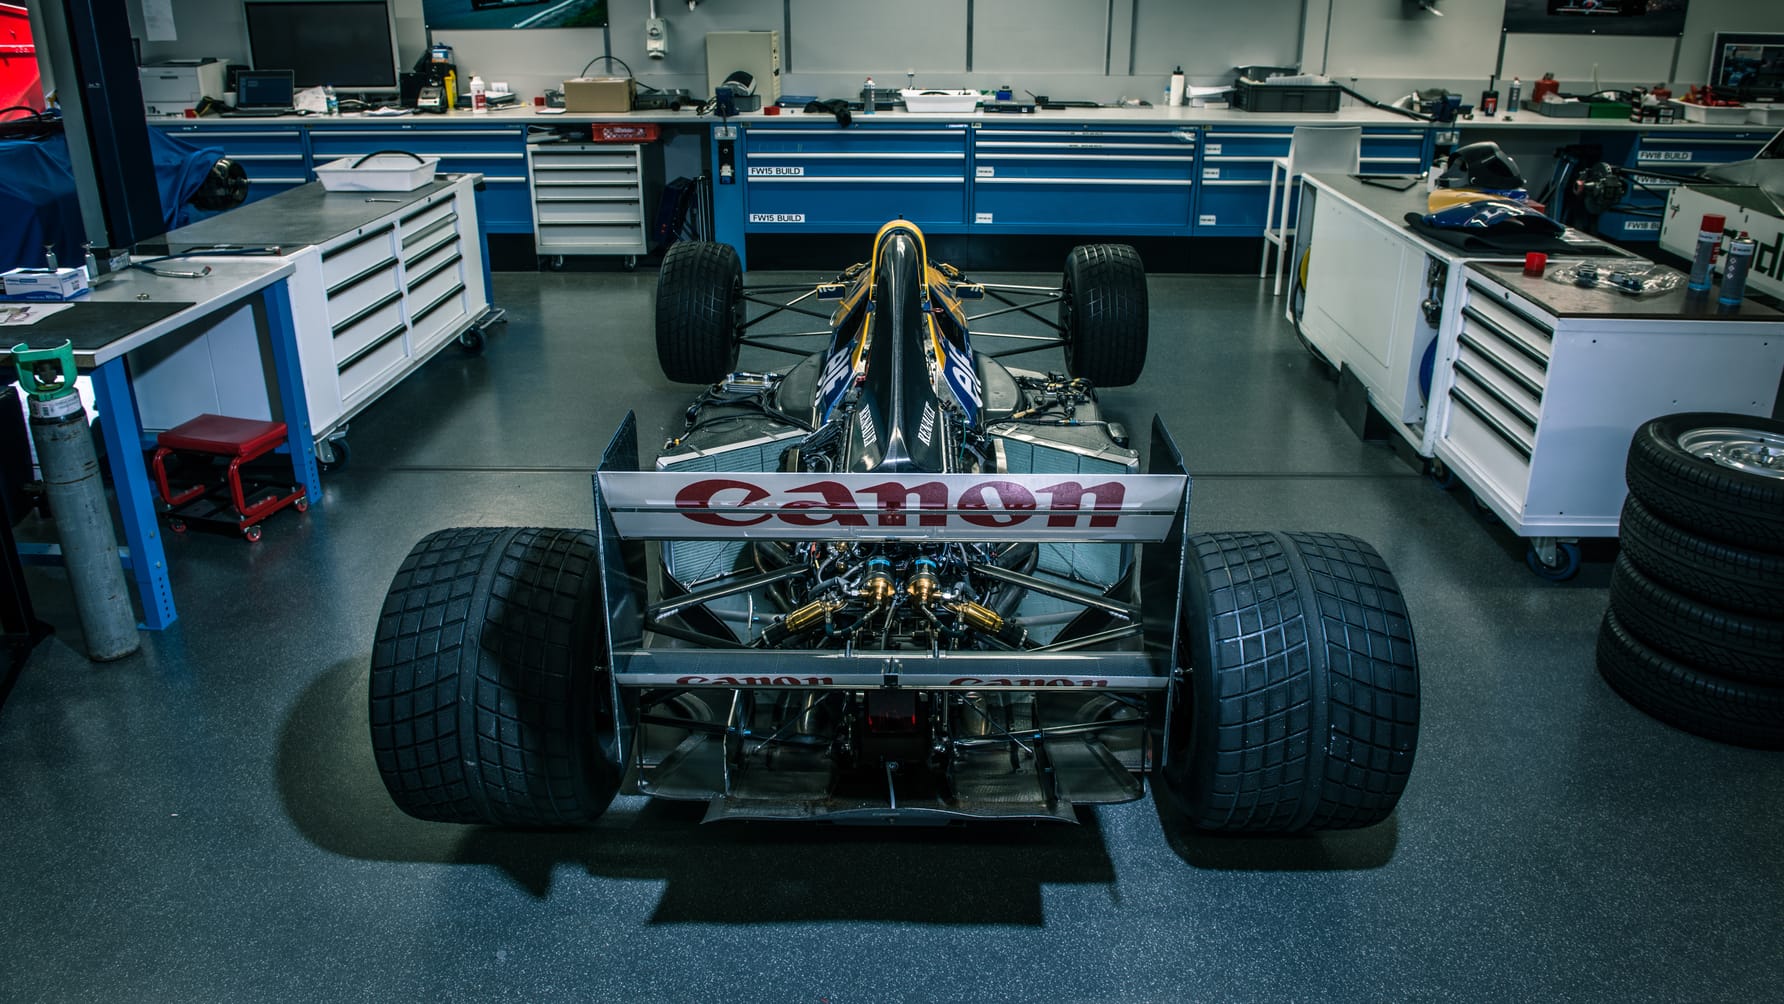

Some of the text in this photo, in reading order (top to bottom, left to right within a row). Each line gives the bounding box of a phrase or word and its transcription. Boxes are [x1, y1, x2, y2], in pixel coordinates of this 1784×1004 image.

[1663, 151, 1689, 159] BUILD
[750, 167, 801, 175] FW15 BUILD
[752, 214, 802, 222] FW15 BUILD
[859, 402, 877, 448] RENAULT
[917, 400, 936, 447] RENAULT
[674, 478, 1126, 528] Canon
